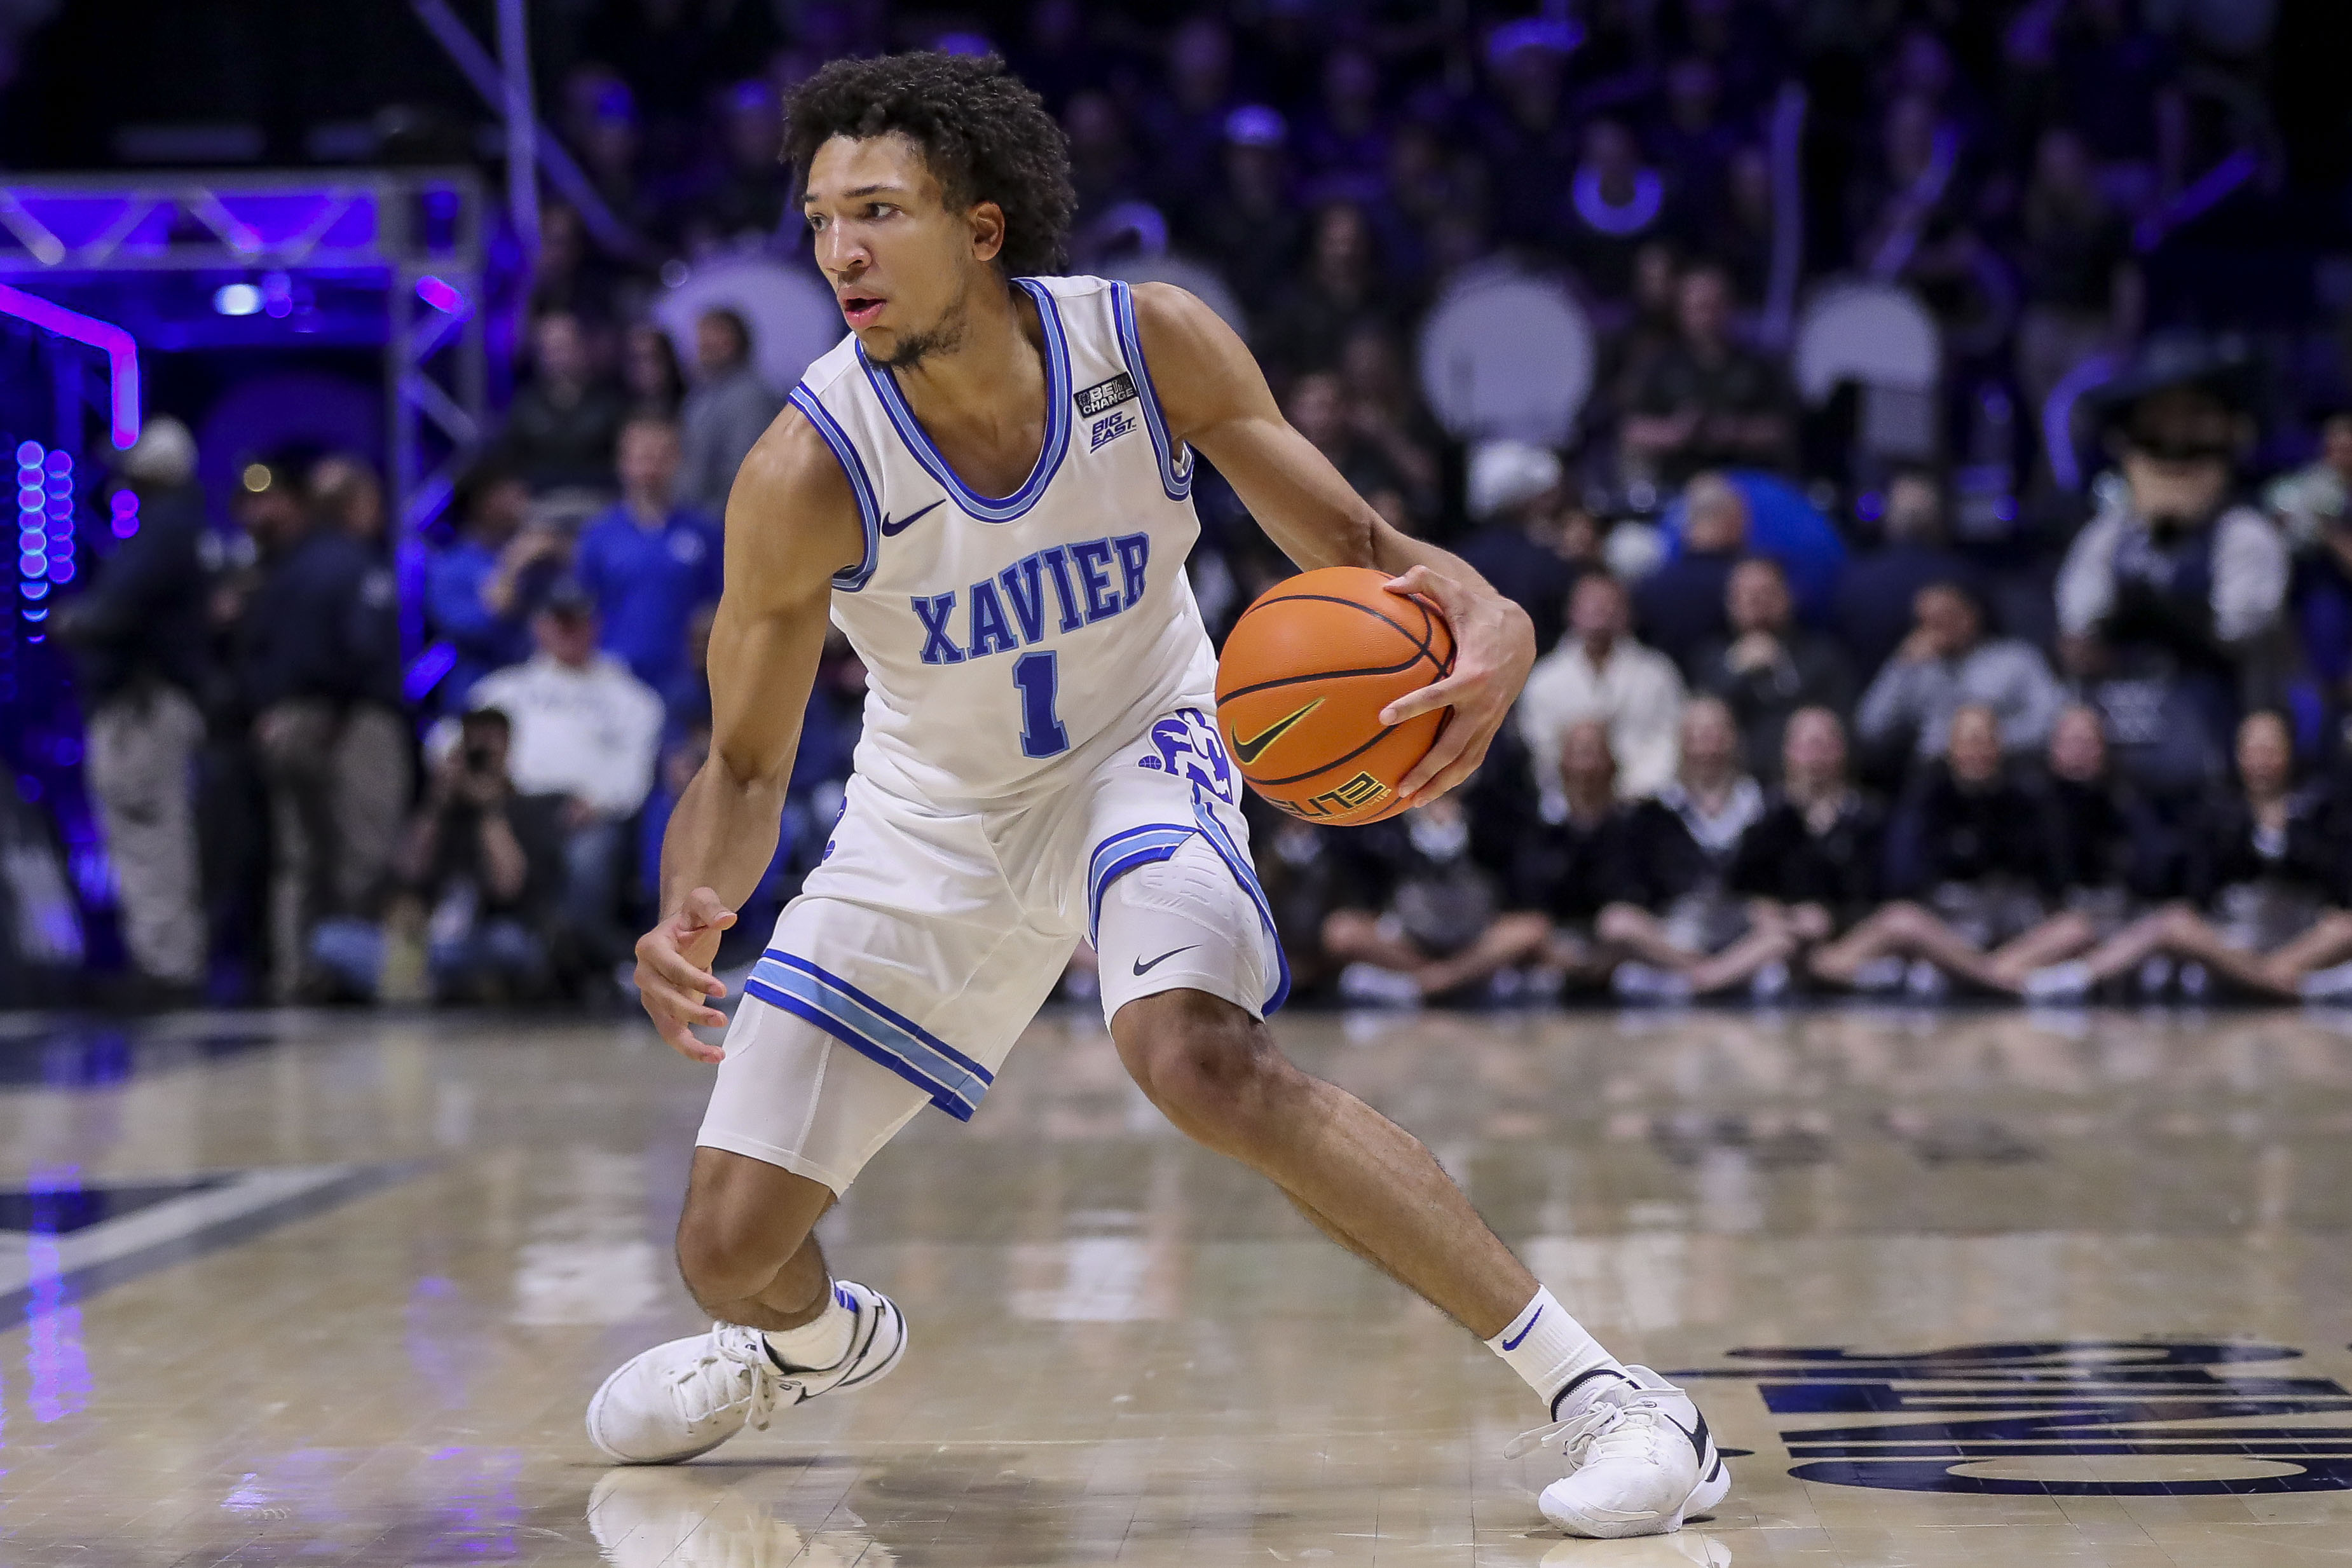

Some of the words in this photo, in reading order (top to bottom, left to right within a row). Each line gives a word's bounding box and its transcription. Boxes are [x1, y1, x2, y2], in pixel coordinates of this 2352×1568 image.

[1083, 387, 1134, 414] CHANGE
[1091, 416, 1135, 447] EAST
[1093, 411, 1123, 435] BIG
[910, 531, 1150, 665] XAVIER
[1012, 650, 1070, 760] 1
